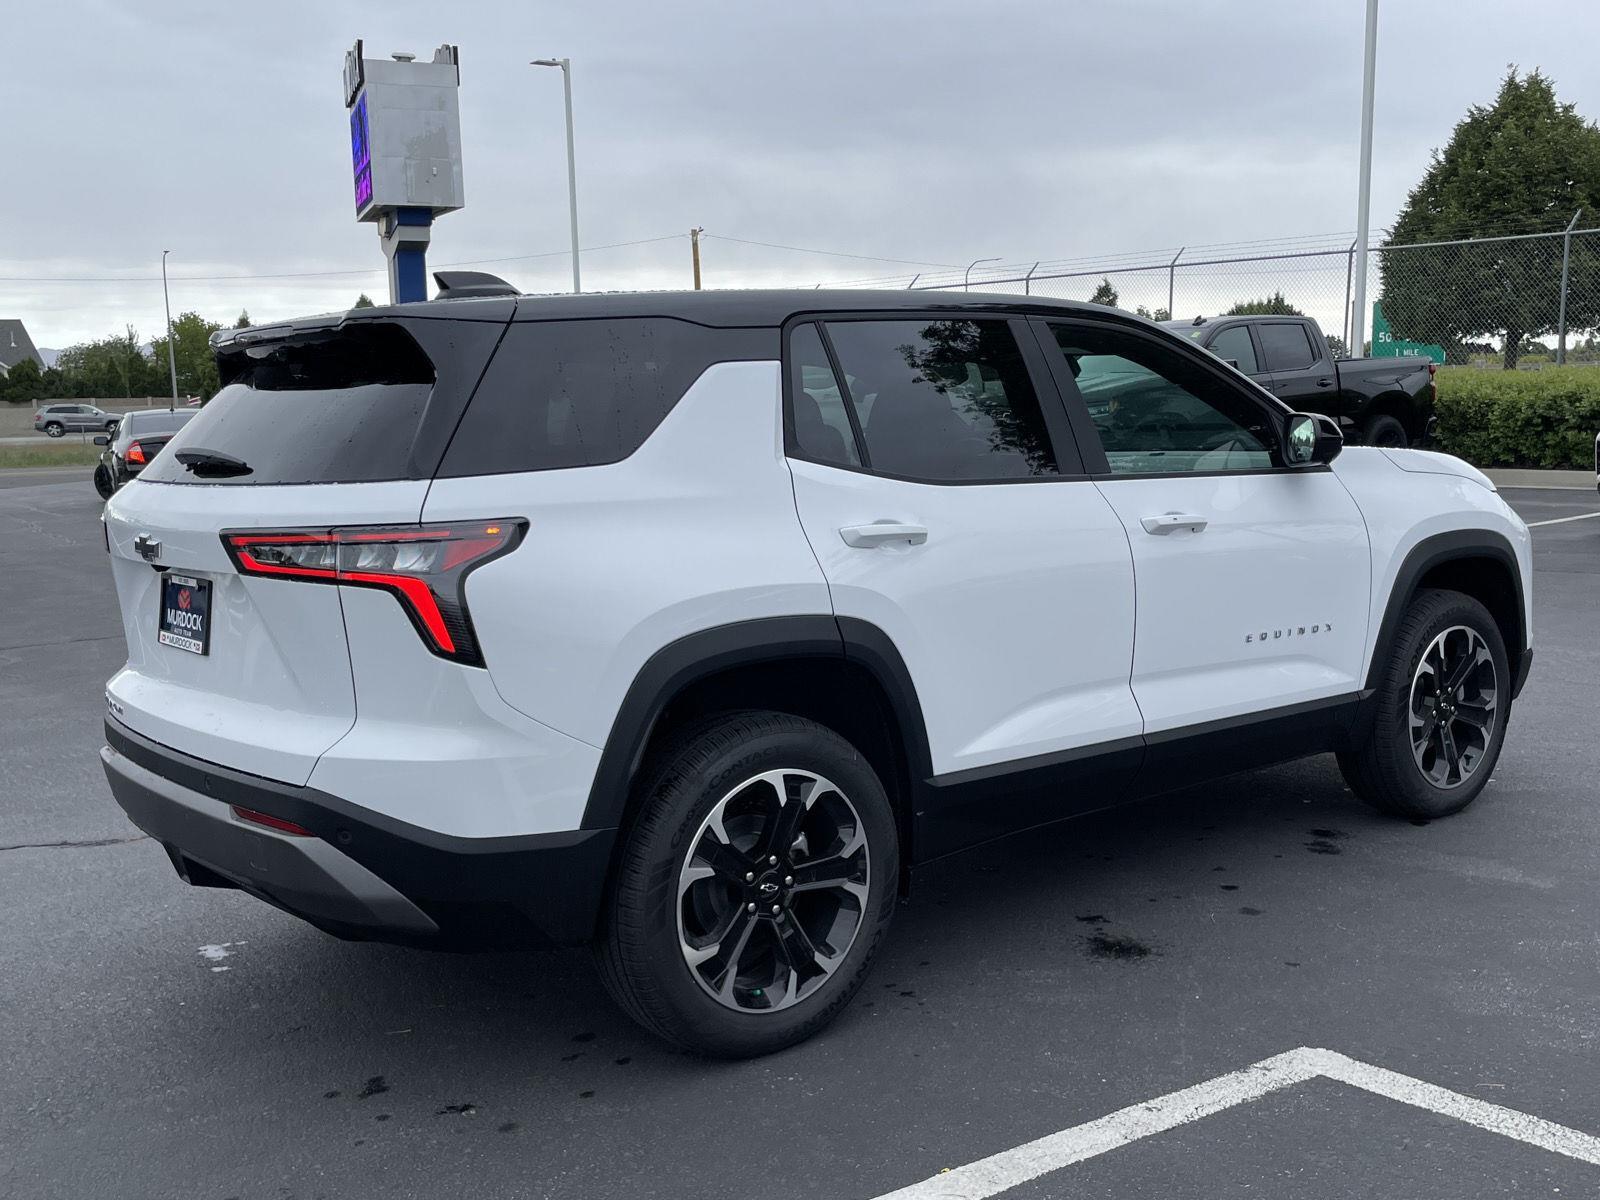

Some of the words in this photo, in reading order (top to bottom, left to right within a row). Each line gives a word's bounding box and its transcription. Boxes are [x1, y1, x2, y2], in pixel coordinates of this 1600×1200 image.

[1403, 348, 1420, 356] MILE
[166, 607, 203, 632] MURDOCK
[1245, 623, 1332, 643] EQUINOX
[168, 635, 193, 649] MURDOCK
